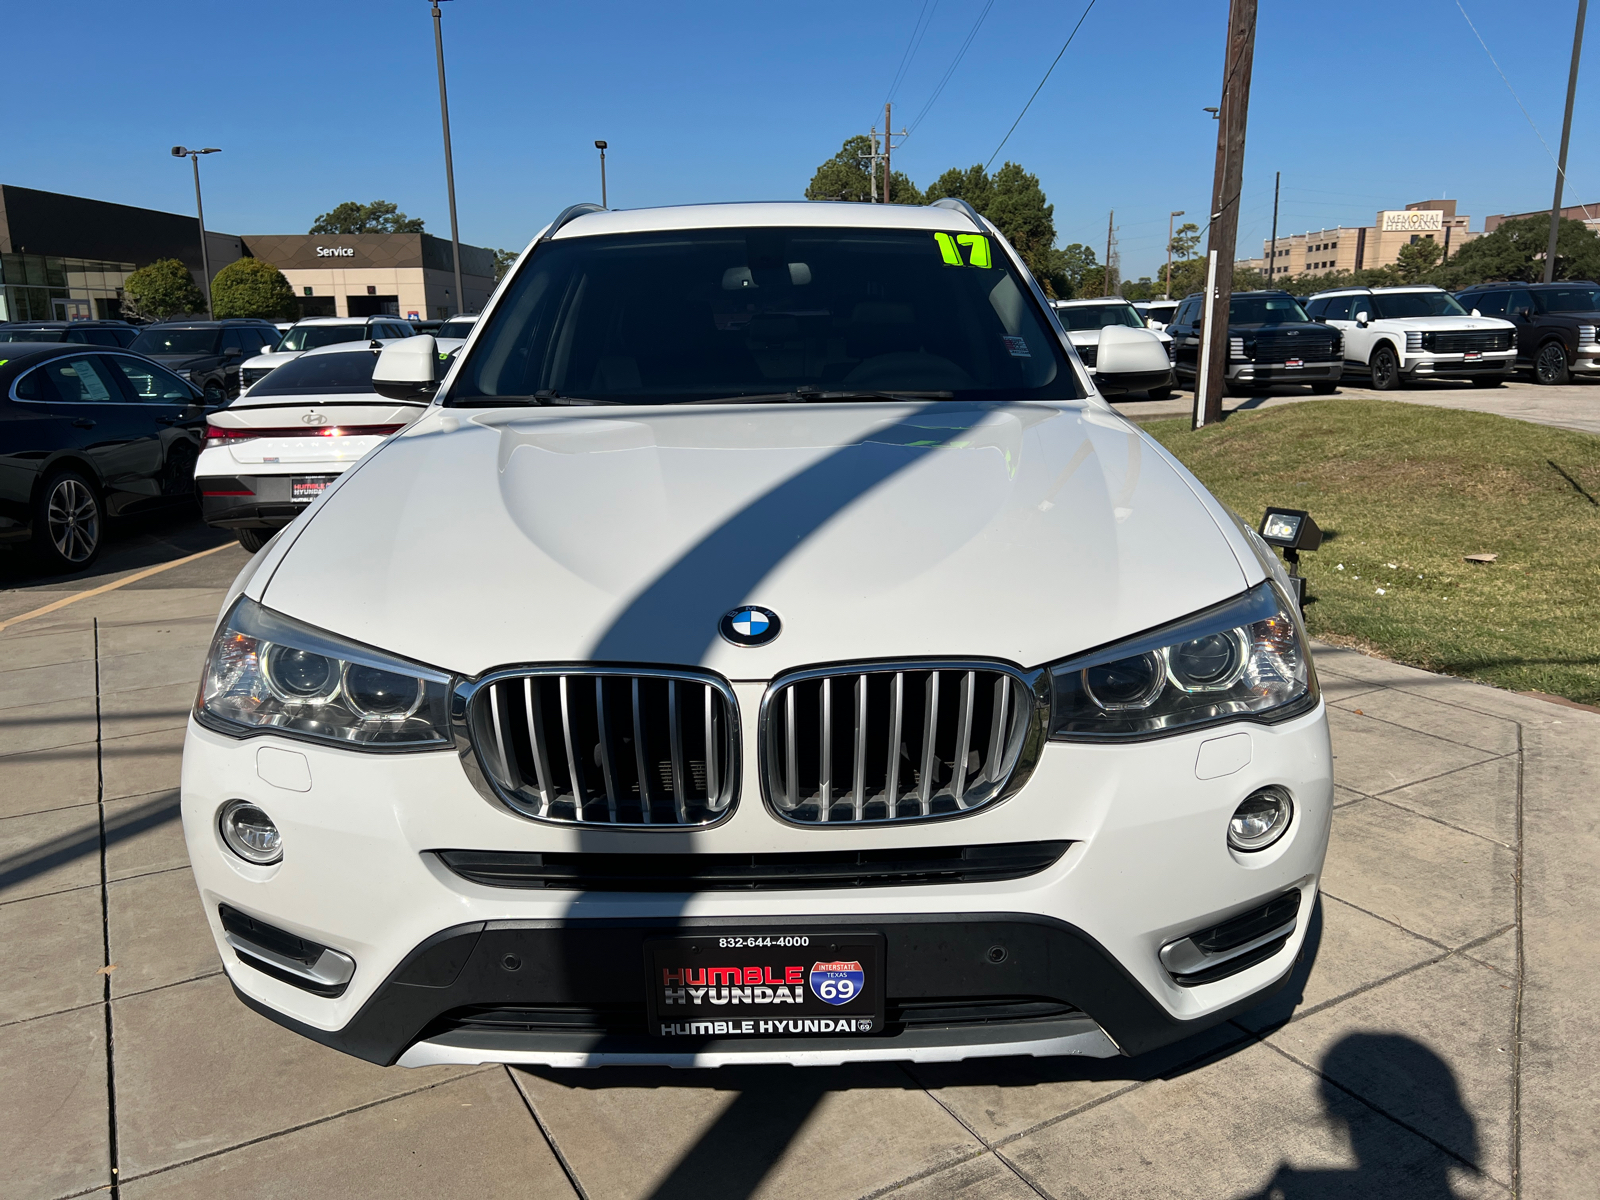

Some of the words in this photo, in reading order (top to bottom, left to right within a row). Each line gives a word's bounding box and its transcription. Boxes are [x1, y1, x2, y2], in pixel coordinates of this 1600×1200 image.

[1386, 214, 1440, 223] MEMORIAL
[1386, 221, 1440, 230] HERMANN
[316, 246, 354, 257] Service
[934, 232, 992, 269] 17
[267, 440, 366, 448] ELANTRA
[727, 606, 776, 618] BMW
[718, 936, 810, 948] 832-644-4000
[662, 966, 804, 986] HUMBLE
[820, 979, 854, 999] 69
[665, 986, 804, 1005] HYUNDAI
[661, 1021, 755, 1036] HUMBLE
[759, 1019, 856, 1033] HYUNDAI
